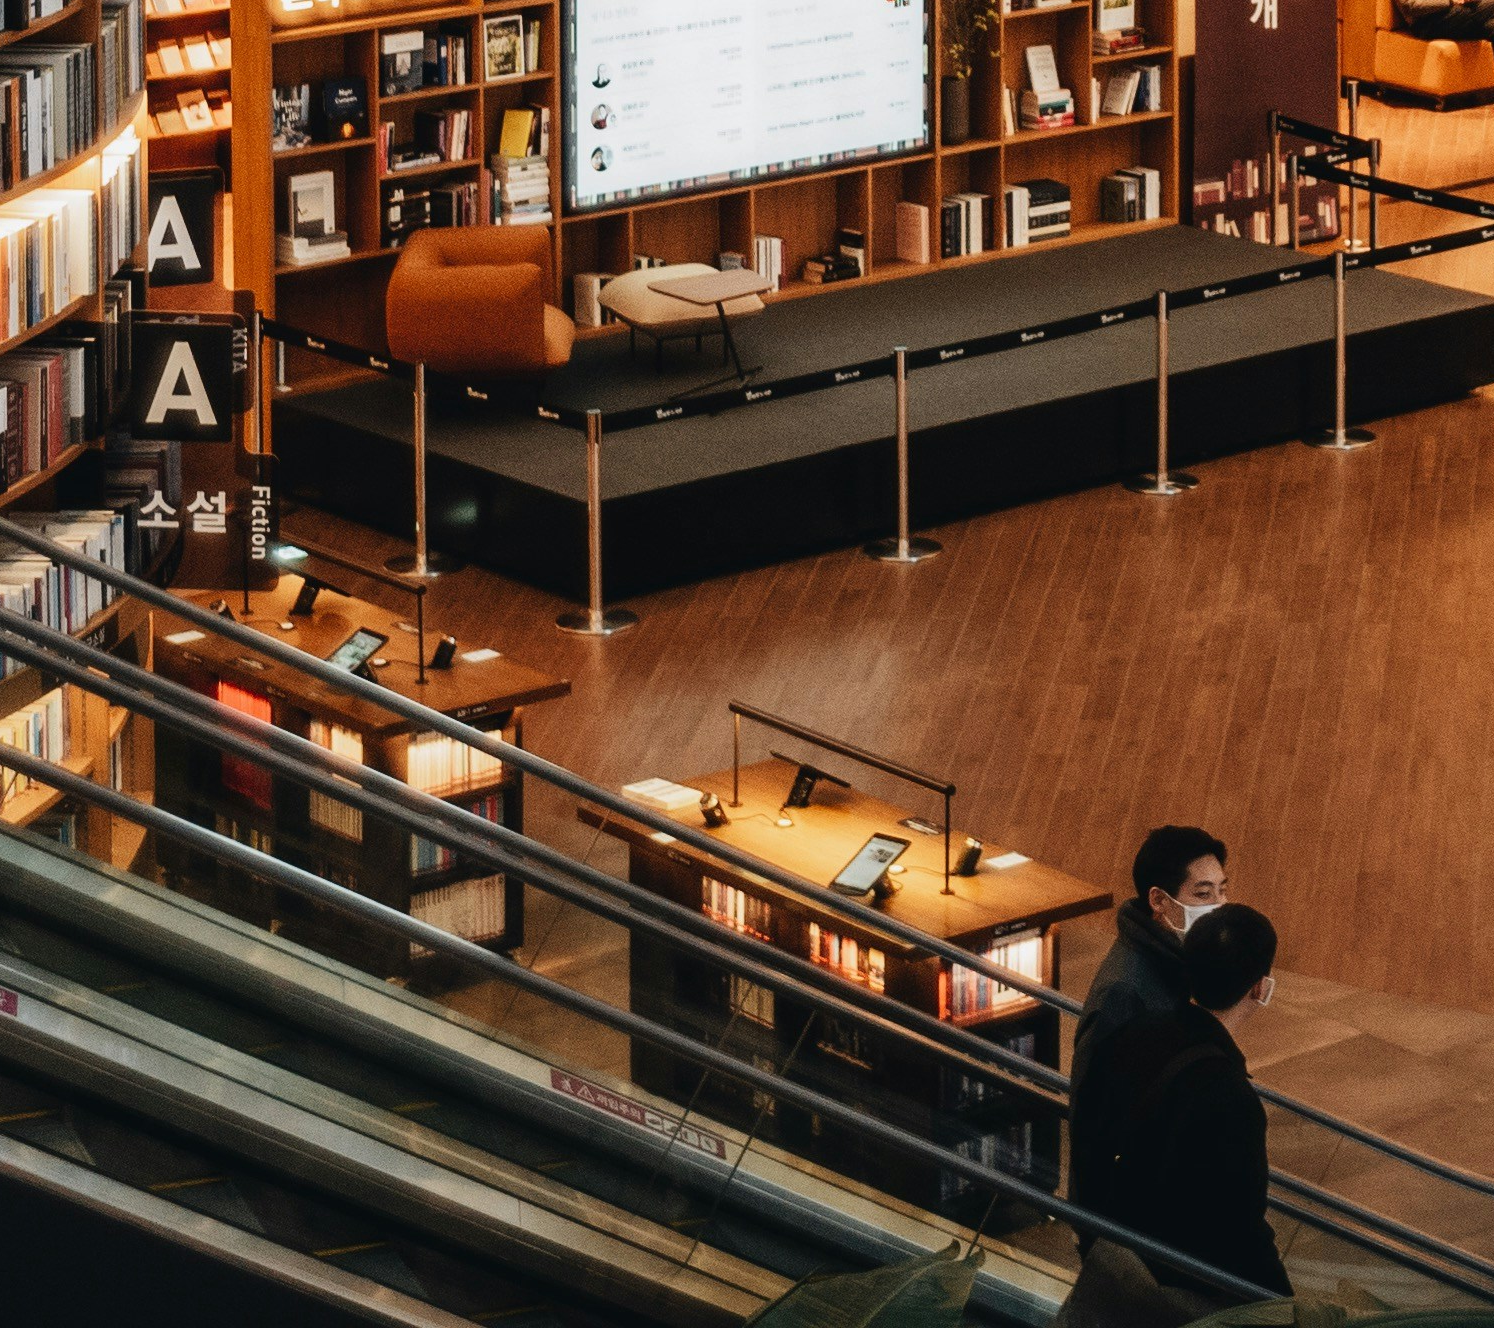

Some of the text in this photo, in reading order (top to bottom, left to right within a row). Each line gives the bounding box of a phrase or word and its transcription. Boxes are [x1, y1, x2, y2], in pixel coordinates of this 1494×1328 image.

[147, 194, 202, 273] A
[145, 340, 218, 426] A
[231, 327, 248, 374] KITA
[137, 489, 227, 535] 소설
[251, 485, 272, 561] Fiction
